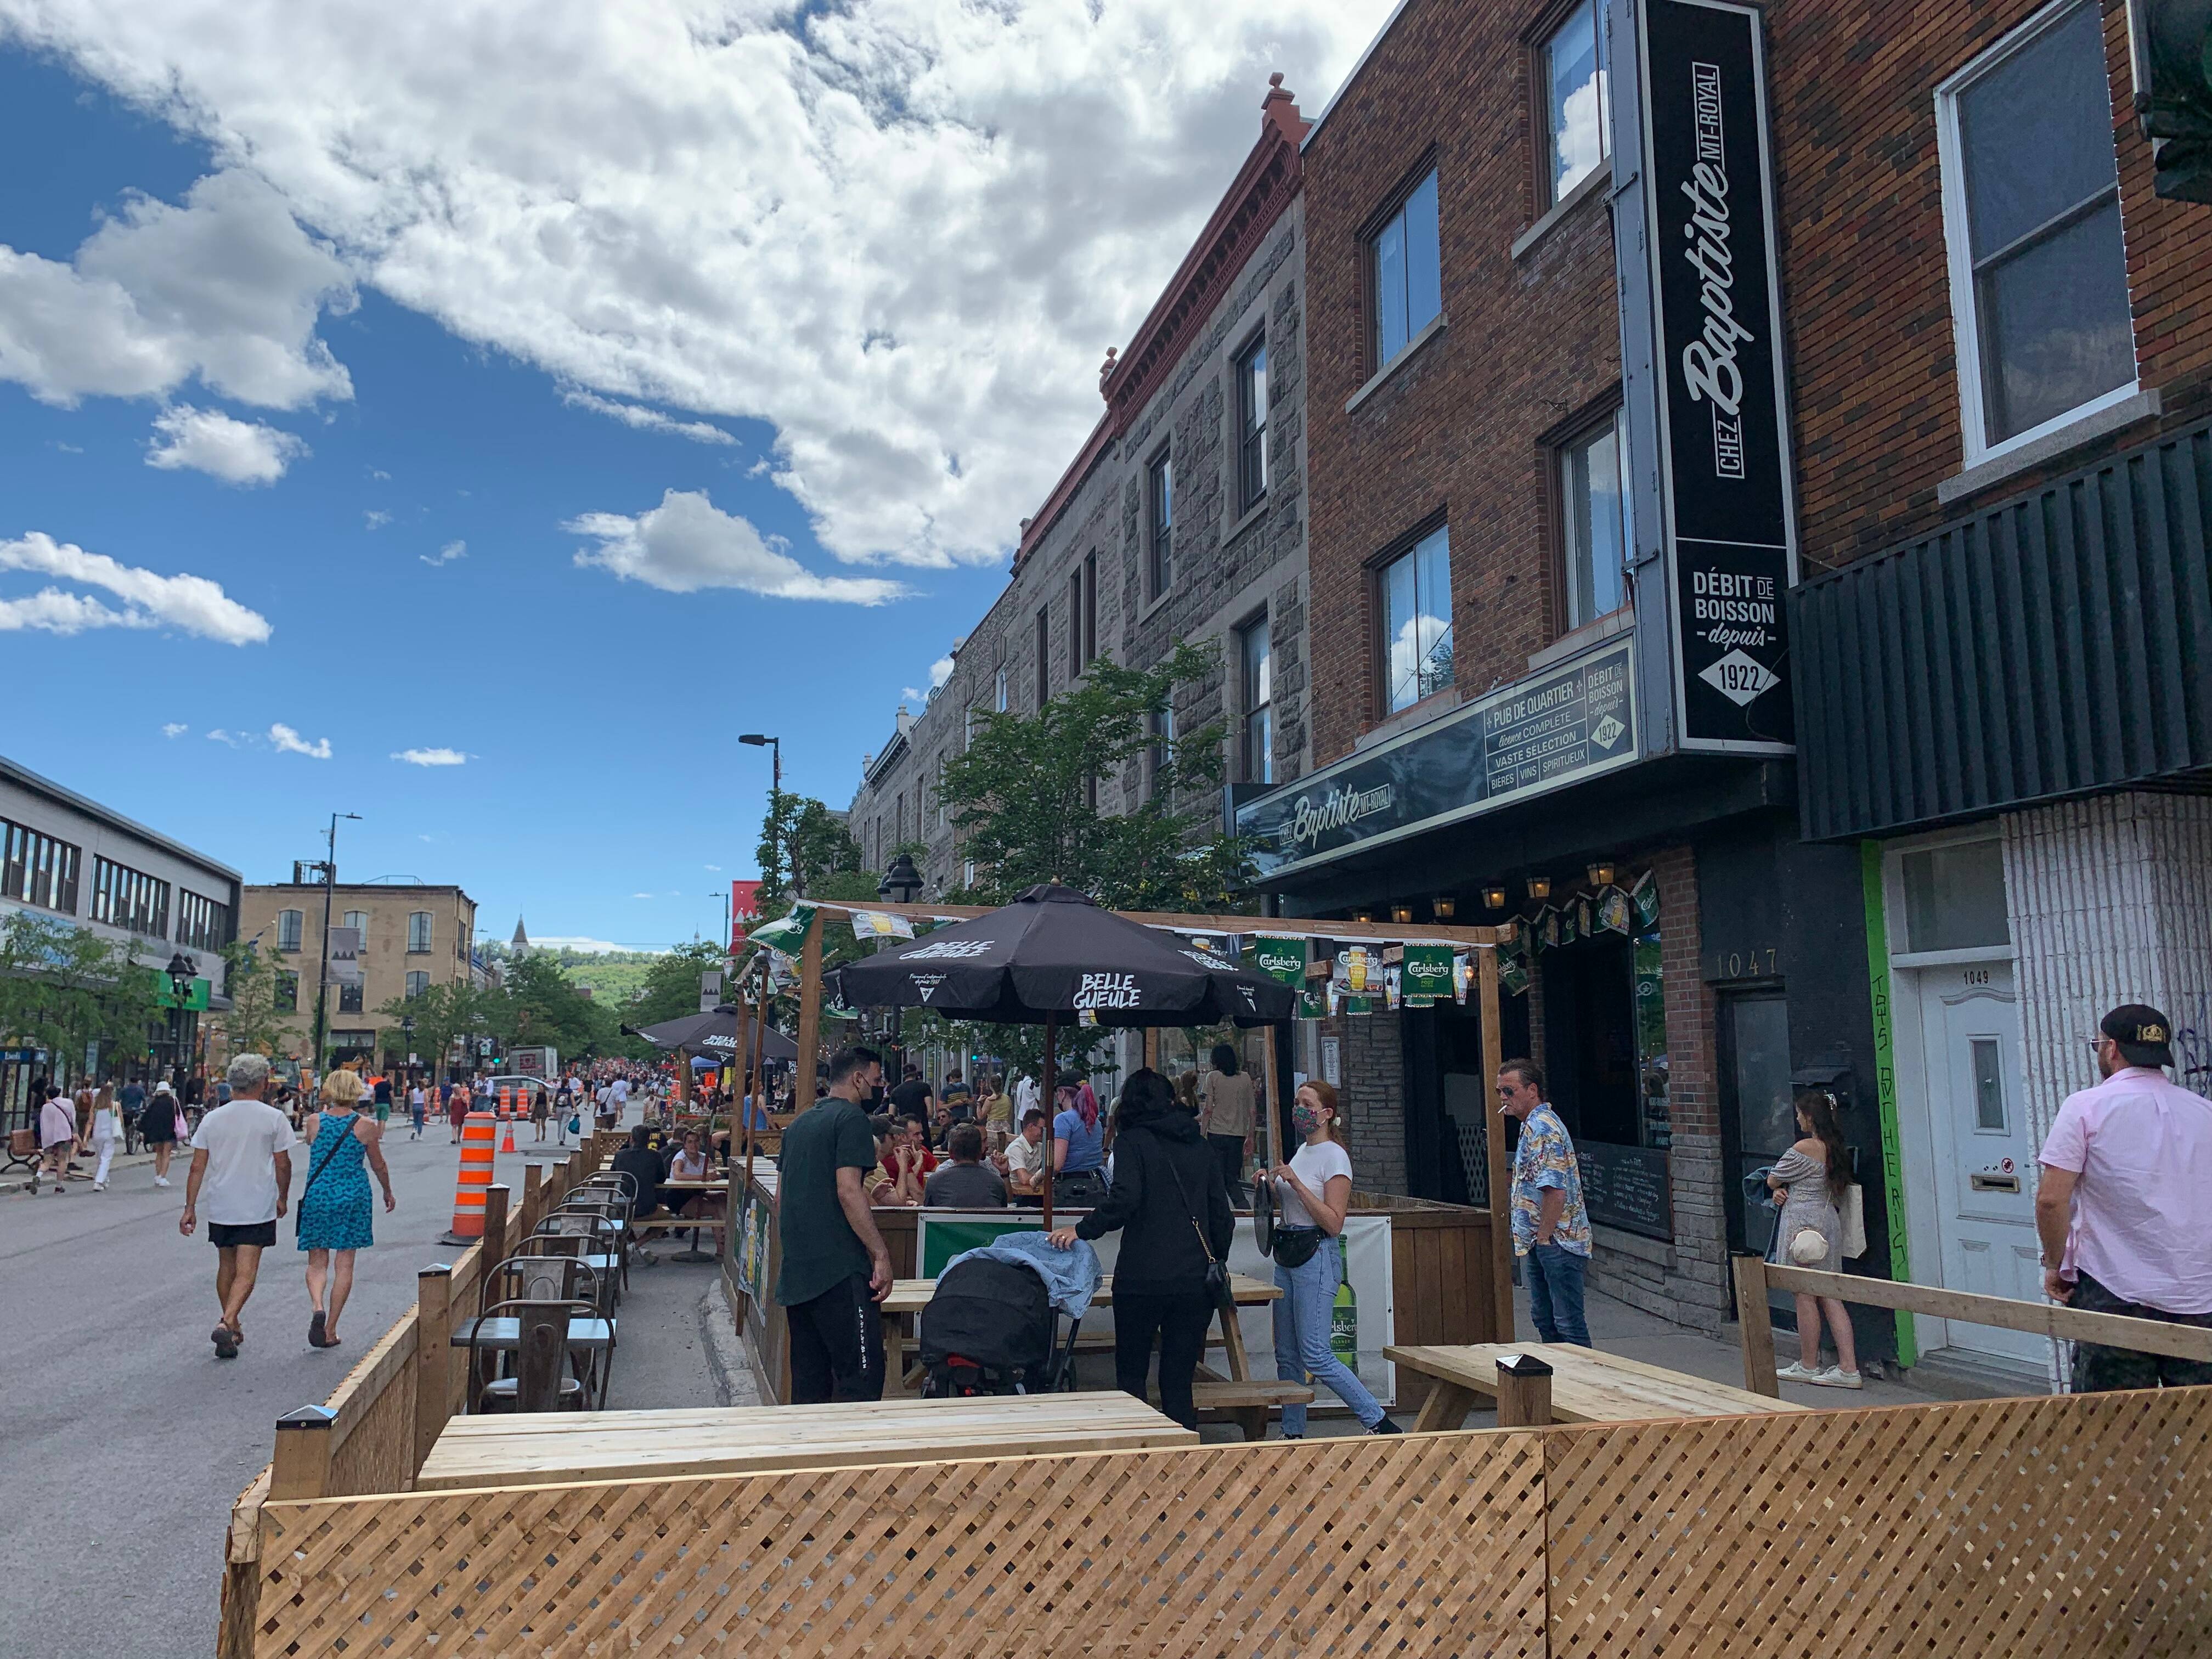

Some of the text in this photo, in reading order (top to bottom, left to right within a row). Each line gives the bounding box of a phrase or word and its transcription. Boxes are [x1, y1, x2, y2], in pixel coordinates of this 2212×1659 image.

[1681, 71, 1754, 470] CHEZ Baptiste MT-ROYAL
[1693, 566, 1774, 598] DÉBIT DE
[1695, 599, 1775, 624] BOISSON
[1588, 666, 1614, 689] DÉBIT
[1719, 664, 1760, 691] 1922
[1589, 679, 1623, 704] BOISSON
[1494, 681, 1573, 729] PUB DE QUARTIER
[1499, 711, 1572, 747] licence COMPLÈTE
[1599, 722, 1617, 743] 1922
[1495, 730, 1576, 768] VASTE SÉLECTION
[1543, 748, 1585, 772] SPIRITUEUX
[1491, 773, 1515, 789] BIÈRES
[1520, 765, 1537, 780] VINS
[1281, 783, 1389, 849] CHEZ Baptiste MT-ROYAL
[899, 947, 991, 960] GUEULE
[926, 940, 995, 950] BELLE
[1259, 953, 1301, 971] Carlsberg
[1339, 951, 1378, 968] Carlsberg
[1408, 962, 1449, 978] Carlsberg
[1716, 948, 1776, 978] 1047
[1081, 973, 1135, 991] BELLE
[1964, 970, 1989, 985] 1049
[1073, 989, 1142, 1009] GUEULE
[702, 1039, 737, 1047] GUEUL
[709, 1035, 737, 1043] BELL
